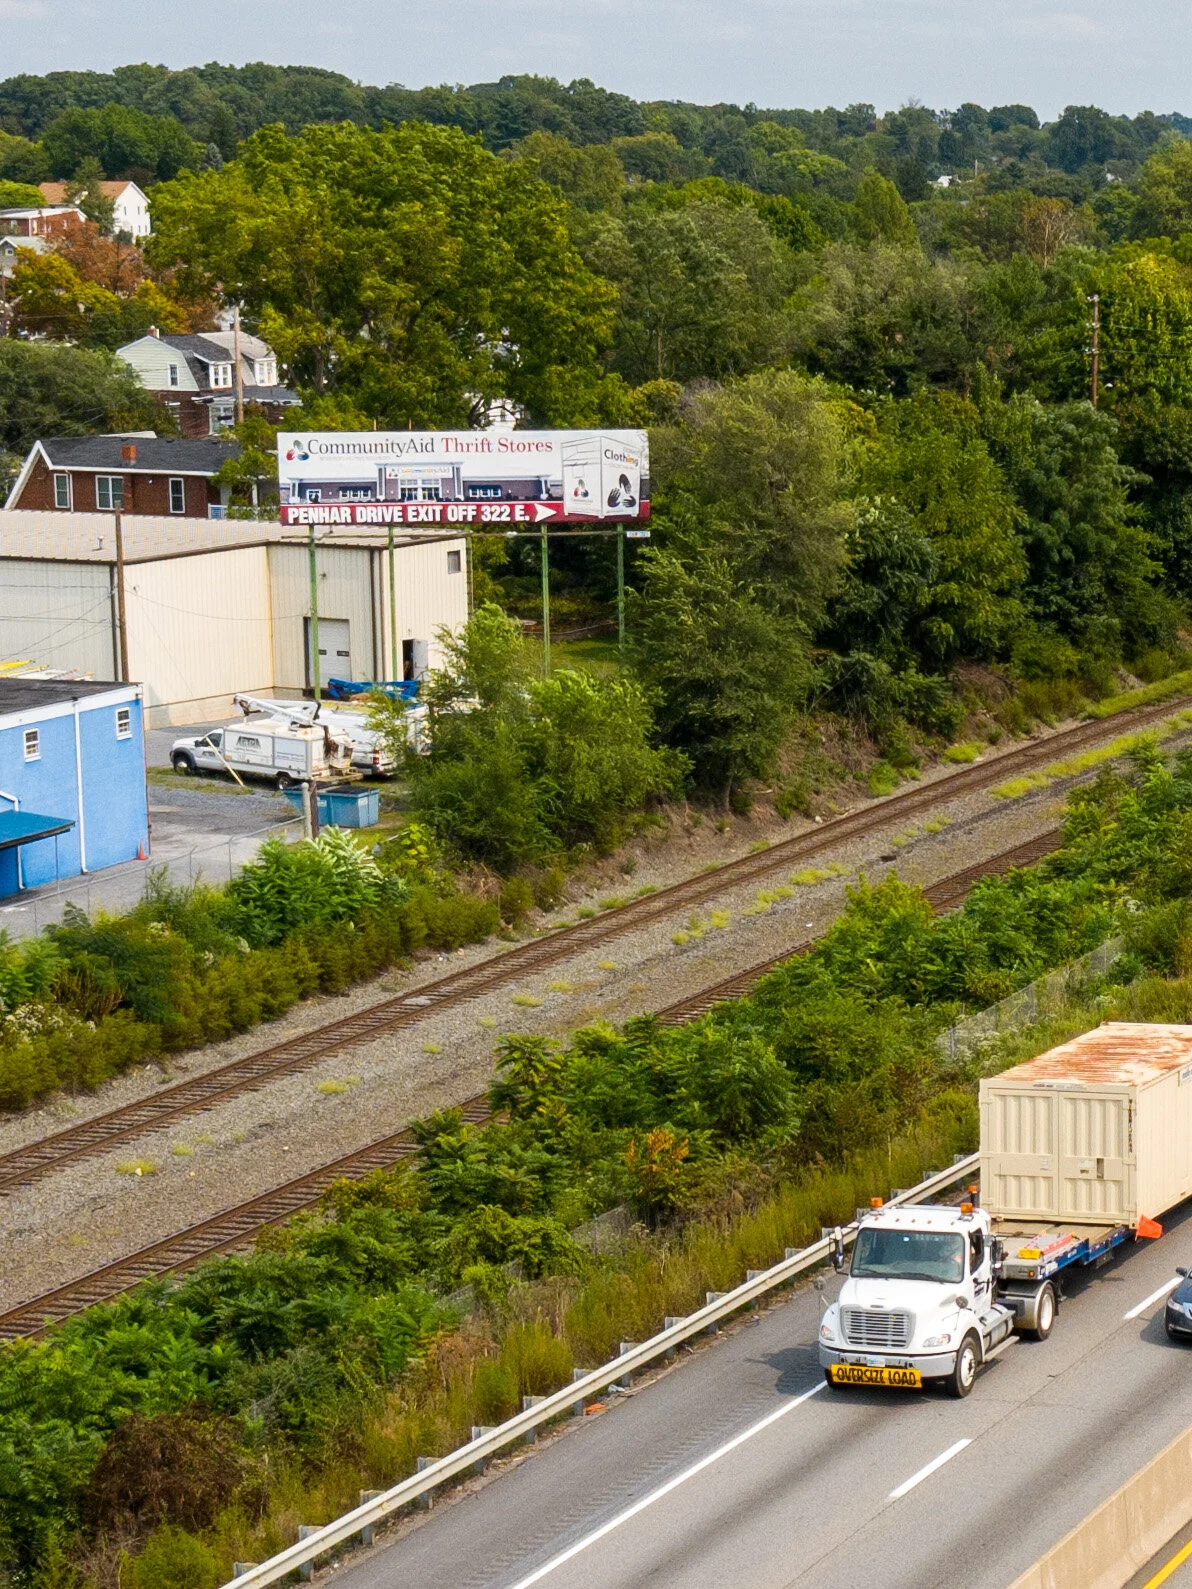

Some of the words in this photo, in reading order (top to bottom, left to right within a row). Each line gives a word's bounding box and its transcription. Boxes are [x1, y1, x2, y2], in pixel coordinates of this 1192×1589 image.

[307, 437, 435, 457] CommunityAid
[441, 436, 493, 453] Thrift
[497, 437, 553, 453] Stores
[287, 506, 352, 524] PENHAR
[355, 505, 403, 523] DRIVE
[407, 504, 443, 522] EXIT
[447, 505, 477, 522] OFF
[481, 505, 511, 522] 322
[515, 504, 530, 521] E.
[836, 1367, 886, 1385] OVERSIZE
[888, 1370, 917, 1386] LOAD
